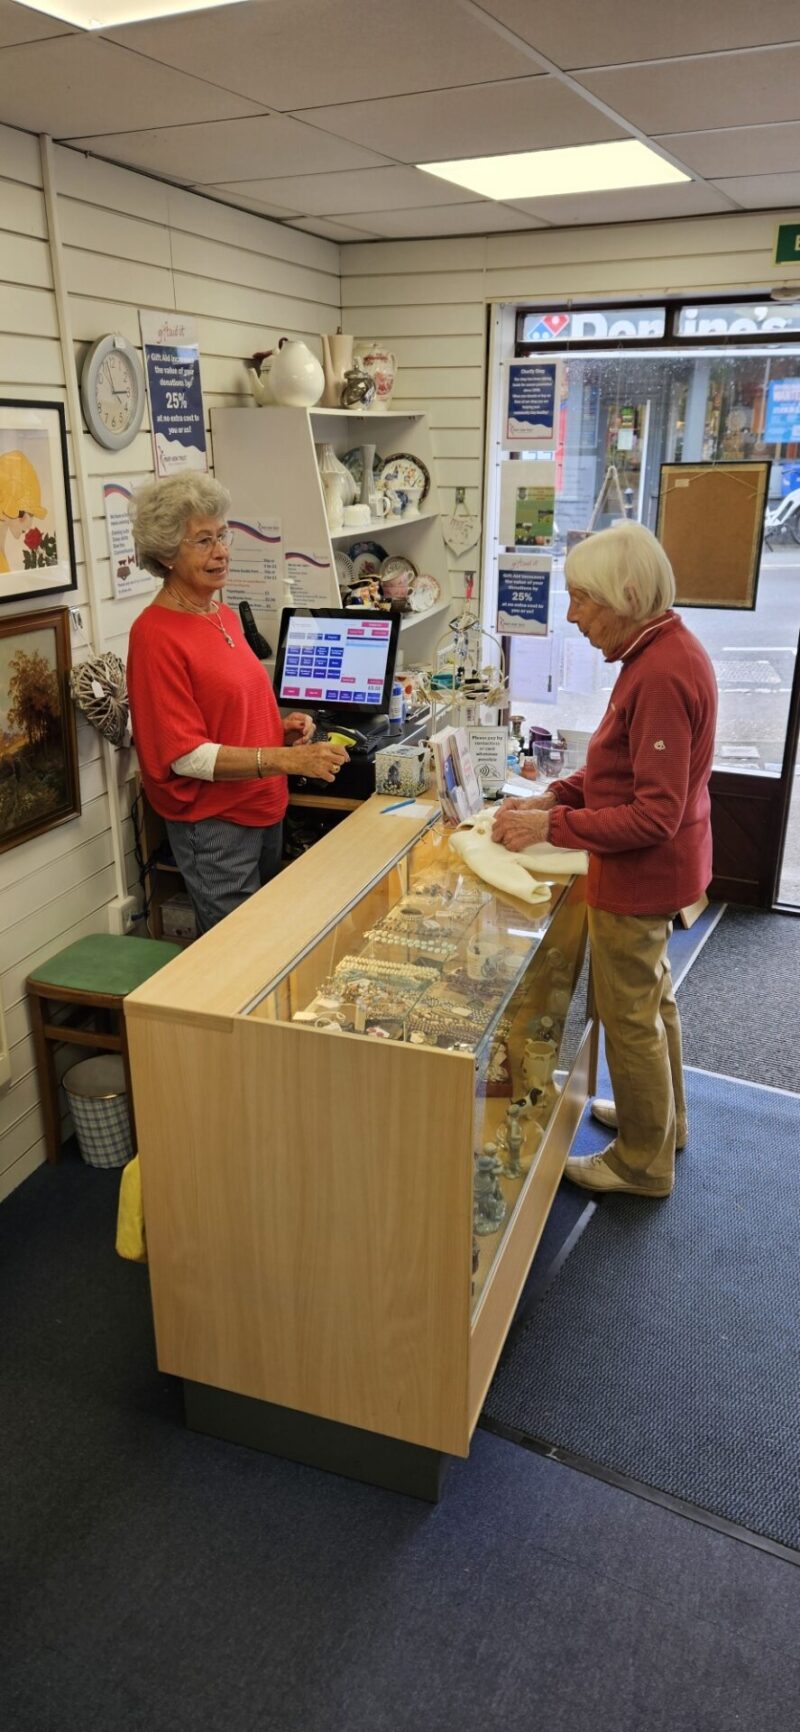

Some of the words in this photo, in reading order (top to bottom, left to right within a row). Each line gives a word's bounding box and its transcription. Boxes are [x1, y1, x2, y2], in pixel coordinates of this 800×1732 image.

[150, 353, 161, 361] Gift
[162, 353, 170, 361] Aid
[155, 366, 163, 374] the
[160, 378, 184, 386] donations
[165, 391, 187, 409] 25%
[168, 427, 177, 435] you
[512, 592, 532, 601] 25%
